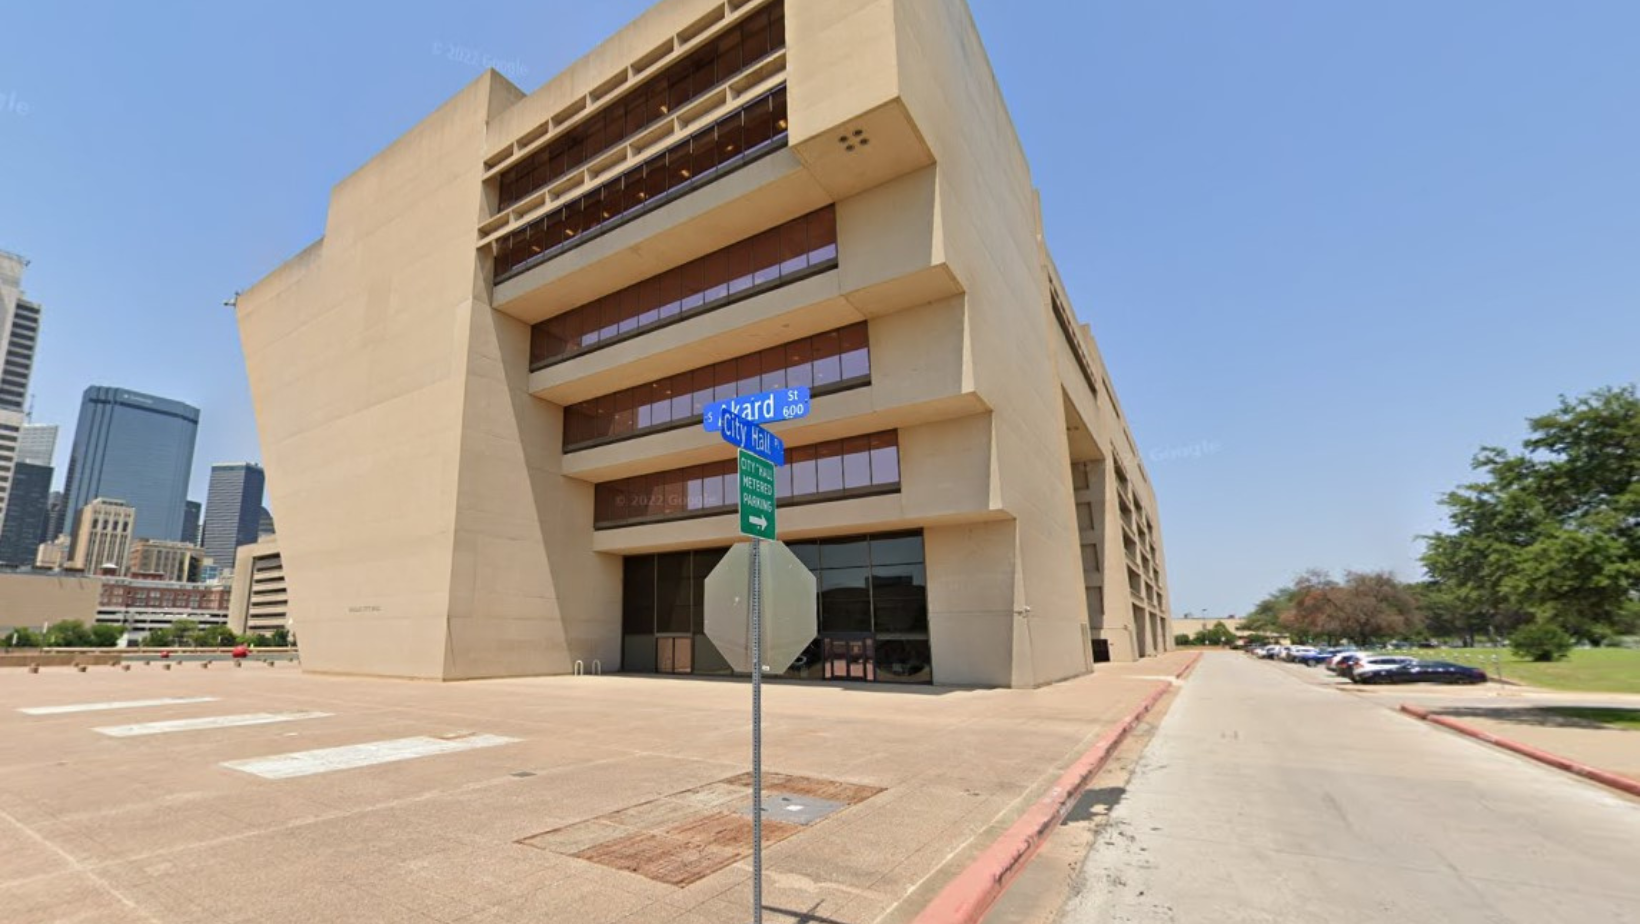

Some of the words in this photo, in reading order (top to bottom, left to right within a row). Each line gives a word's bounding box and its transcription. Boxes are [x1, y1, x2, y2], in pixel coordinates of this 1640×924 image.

[719, 393, 774, 427] kard
[787, 389, 799, 401] St
[782, 404, 804, 417] 600
[724, 413, 747, 448] City
[751, 425, 772, 455] Hall
[741, 457, 756, 473] CITY
[742, 474, 773, 496] METERED
[742, 492, 773, 513] PARKING
